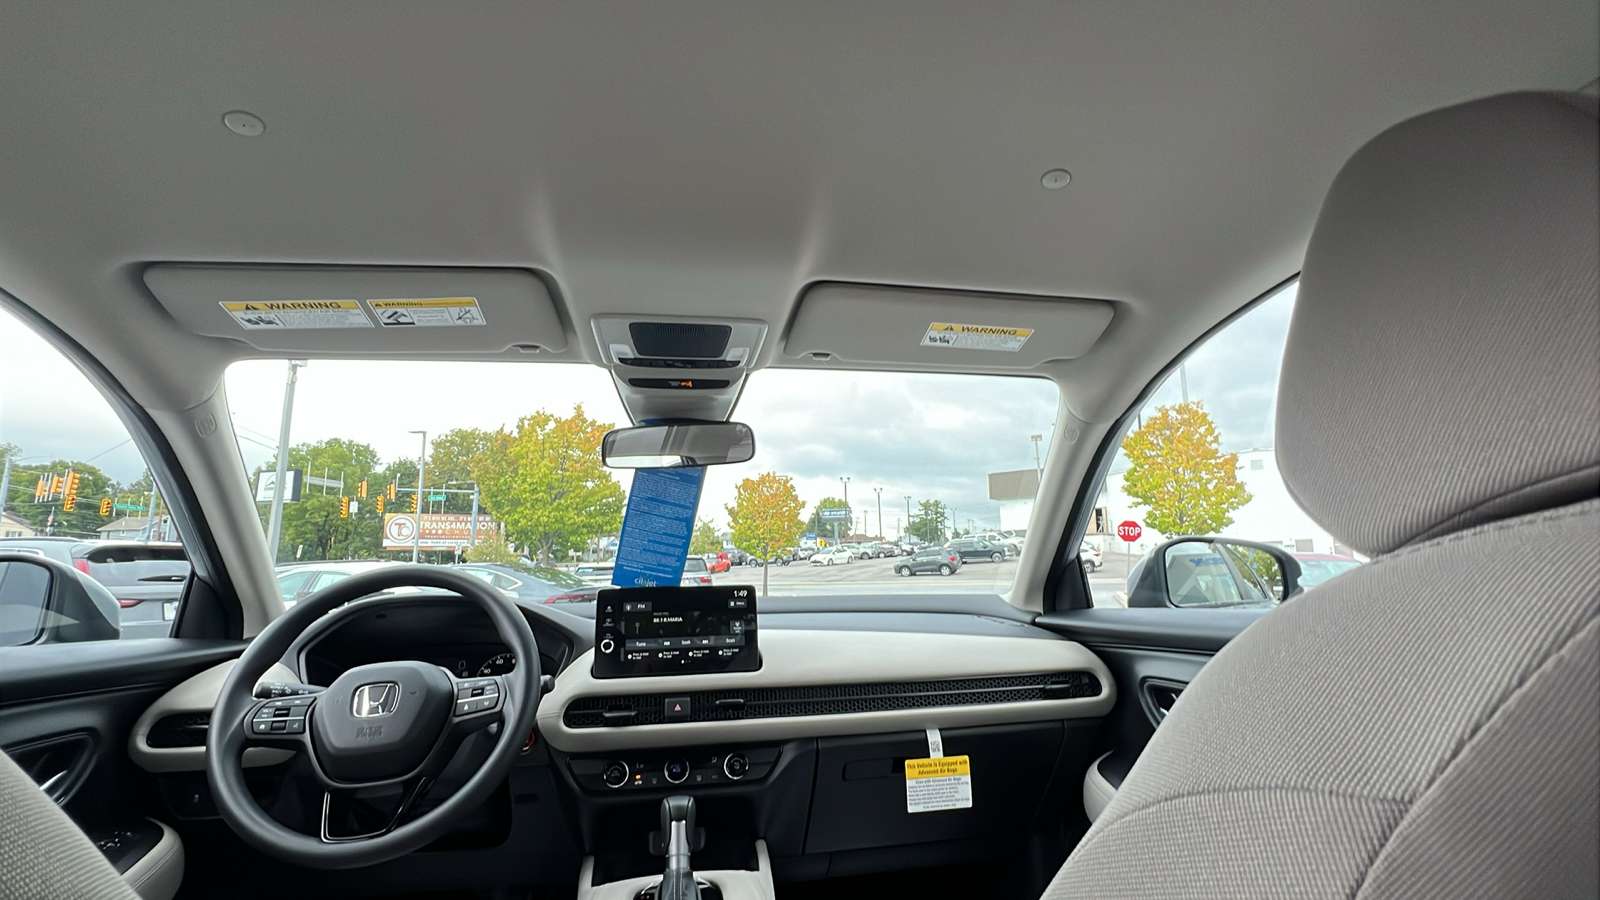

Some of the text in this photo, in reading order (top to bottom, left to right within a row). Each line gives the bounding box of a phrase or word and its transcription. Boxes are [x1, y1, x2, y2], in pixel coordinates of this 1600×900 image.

[264, 302, 341, 310] WARNING
[961, 326, 1018, 336] WARNING
[420, 522, 495, 530] TRANS4MAION
[1118, 526, 1141, 536] STOP
